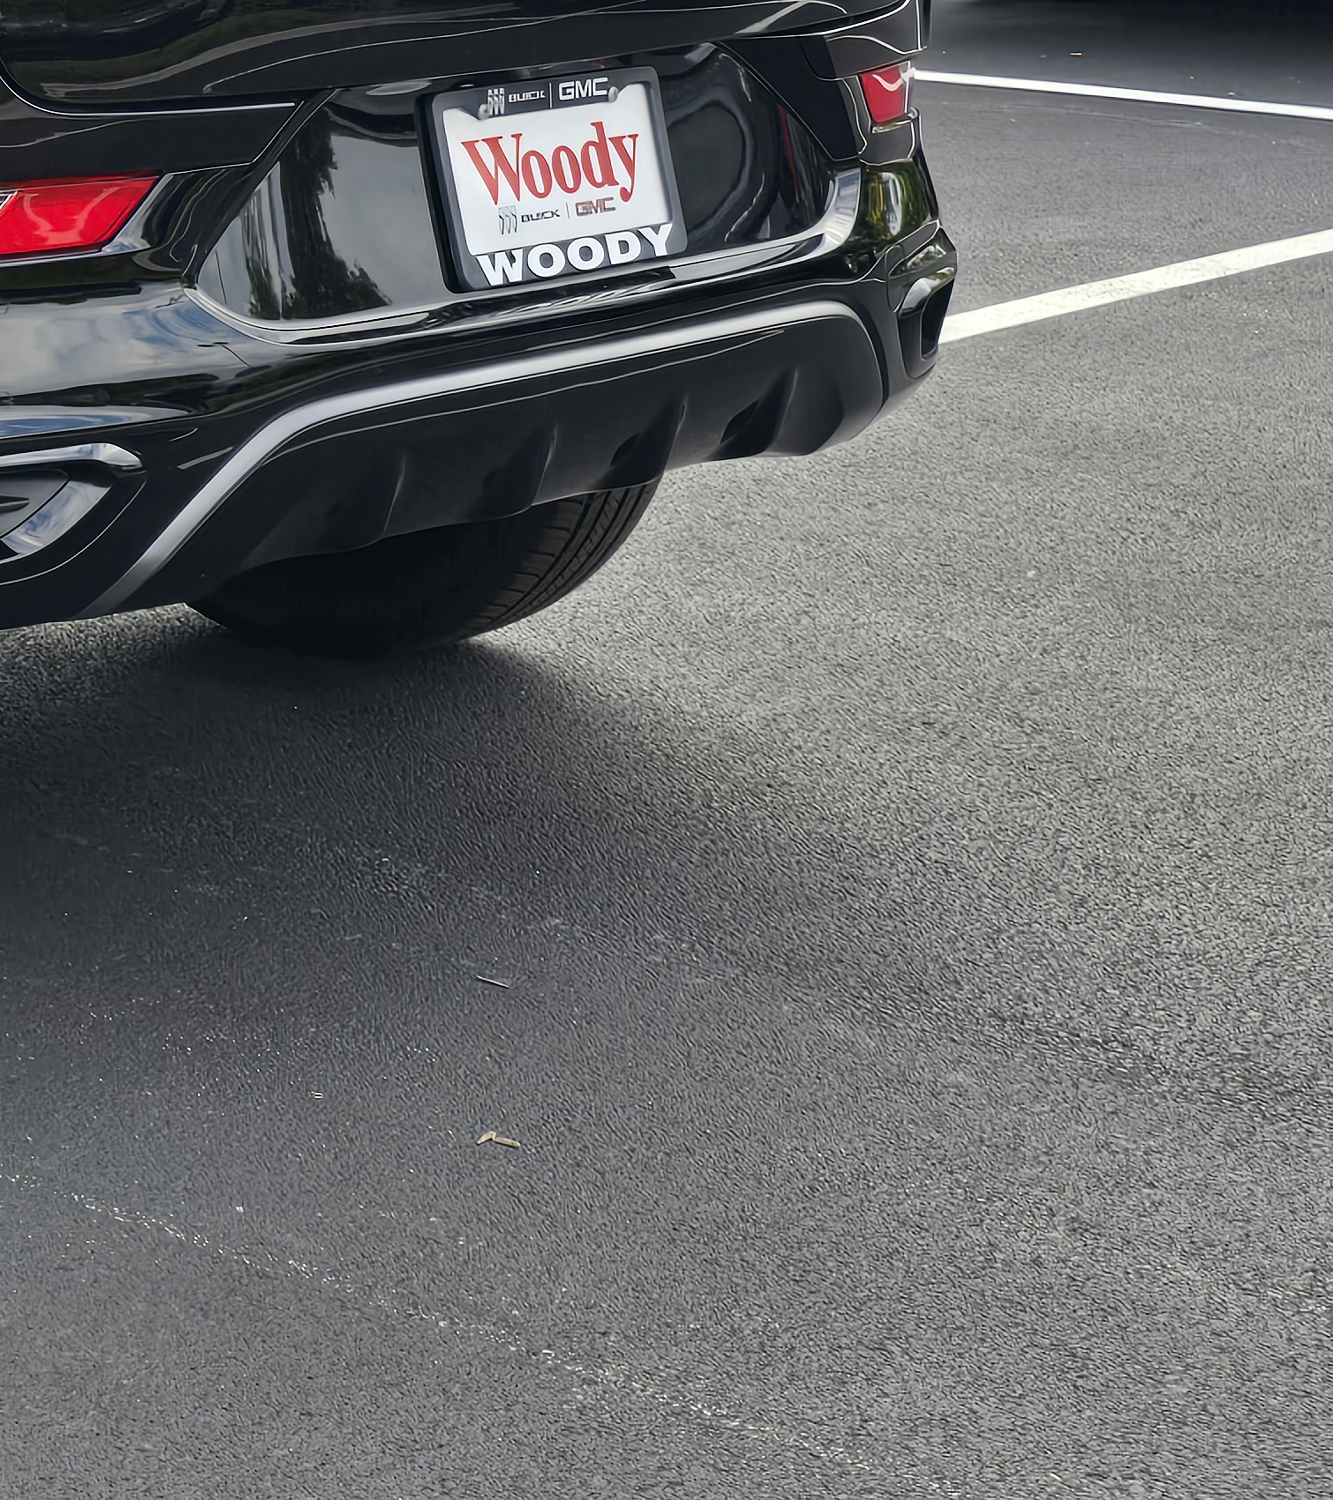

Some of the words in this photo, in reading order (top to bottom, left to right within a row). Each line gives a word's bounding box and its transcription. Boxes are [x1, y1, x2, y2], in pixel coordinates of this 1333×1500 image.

[558, 77, 609, 101] GMC
[461, 121, 639, 206] Woody
[575, 196, 617, 217] GMC
[476, 223, 674, 287] WOODY
